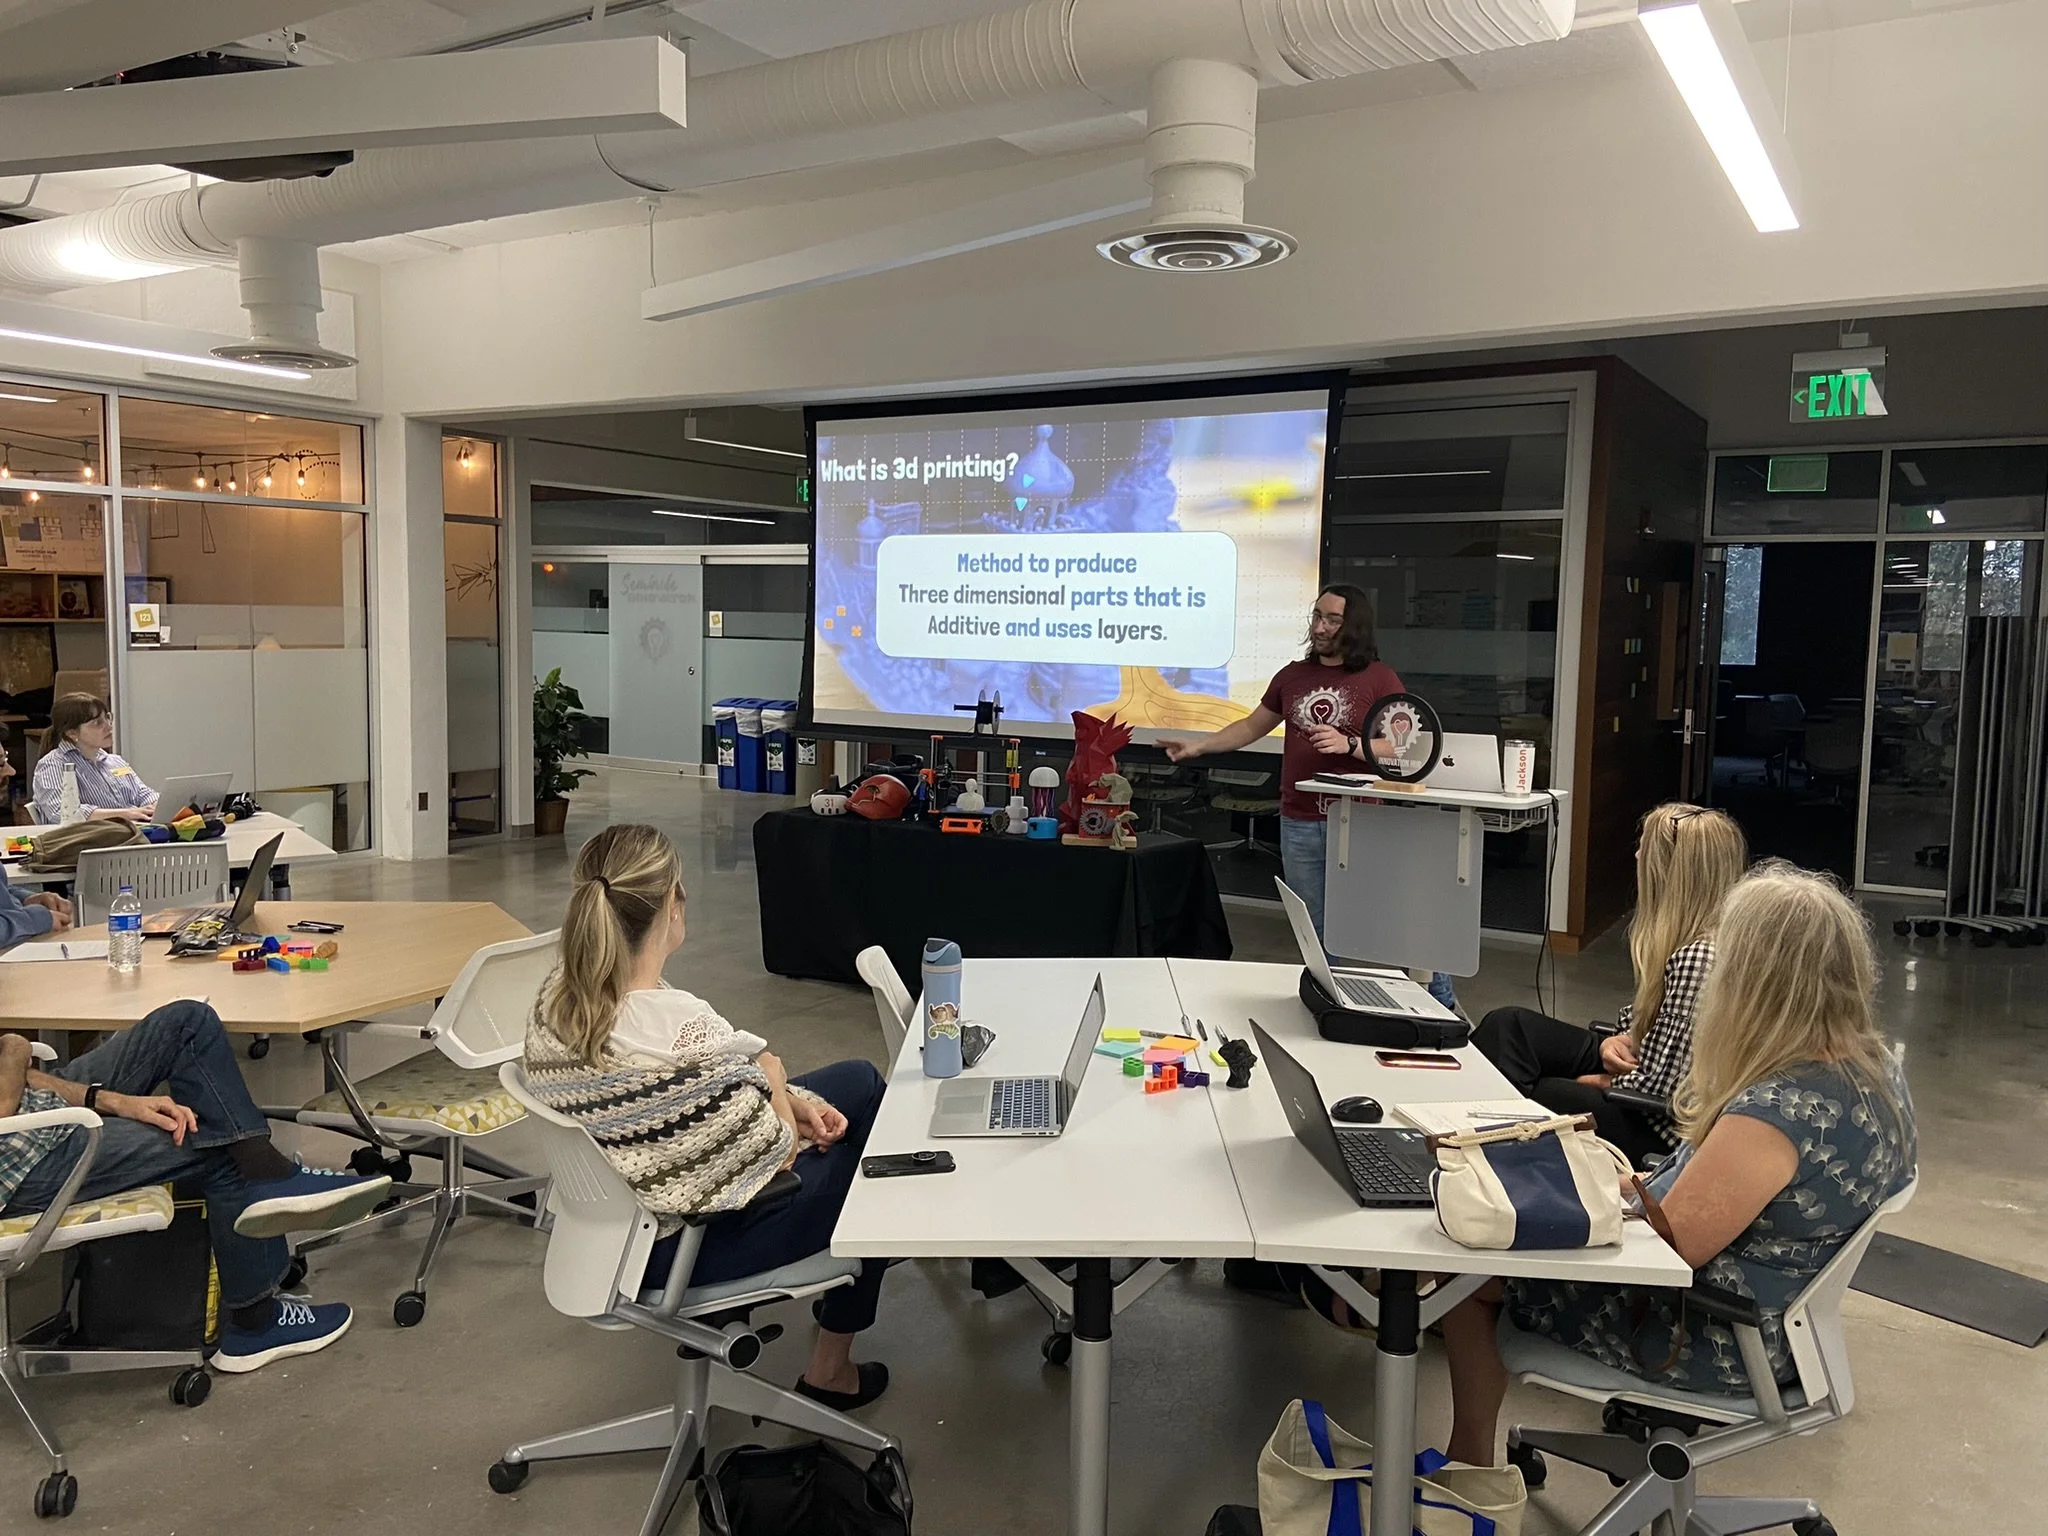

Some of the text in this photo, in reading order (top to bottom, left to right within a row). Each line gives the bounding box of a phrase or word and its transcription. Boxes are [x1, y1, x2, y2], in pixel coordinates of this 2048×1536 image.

[1808, 372, 1871, 418] EXIT
[820, 452, 1019, 485] What is 3d printing?
[957, 553, 1137, 578] Method to produce
[899, 583, 1206, 611] Three dimensional parts that is
[928, 615, 1167, 644] Additive and uses layers.
[1516, 749, 1528, 791] Jackson
[824, 799, 834, 807] 31
